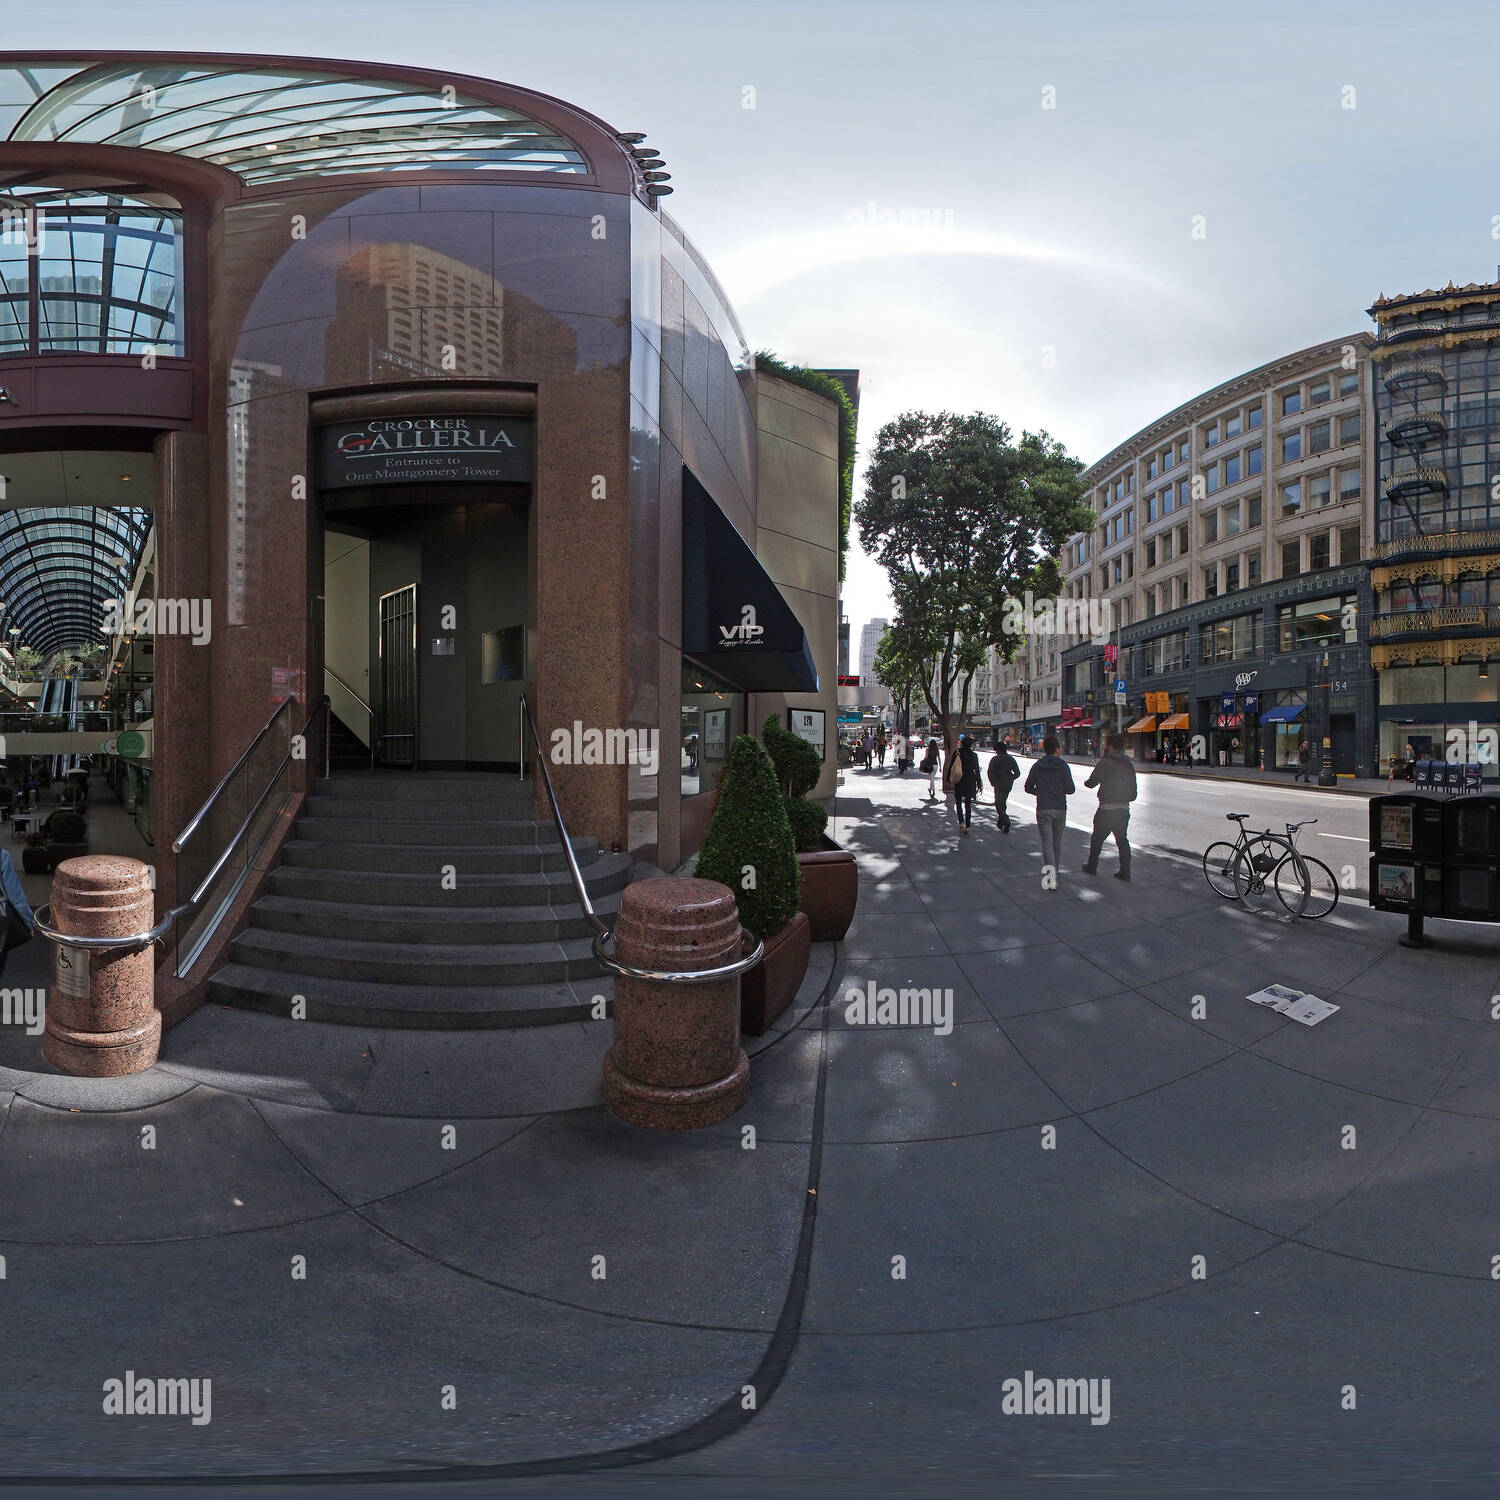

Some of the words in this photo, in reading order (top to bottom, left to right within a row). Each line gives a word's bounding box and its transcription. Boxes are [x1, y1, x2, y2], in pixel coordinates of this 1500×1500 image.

[367, 418, 470, 433] CROCKER
[337, 429, 517, 453] GALLERIA
[385, 458, 443, 467] Entrance
[447, 457, 461, 465] to
[345, 472, 372, 481] One
[375, 467, 459, 479] Montgomery
[462, 466, 502, 477] Tower
[719, 625, 764, 639] VIP
[1330, 681, 1347, 691] 154
